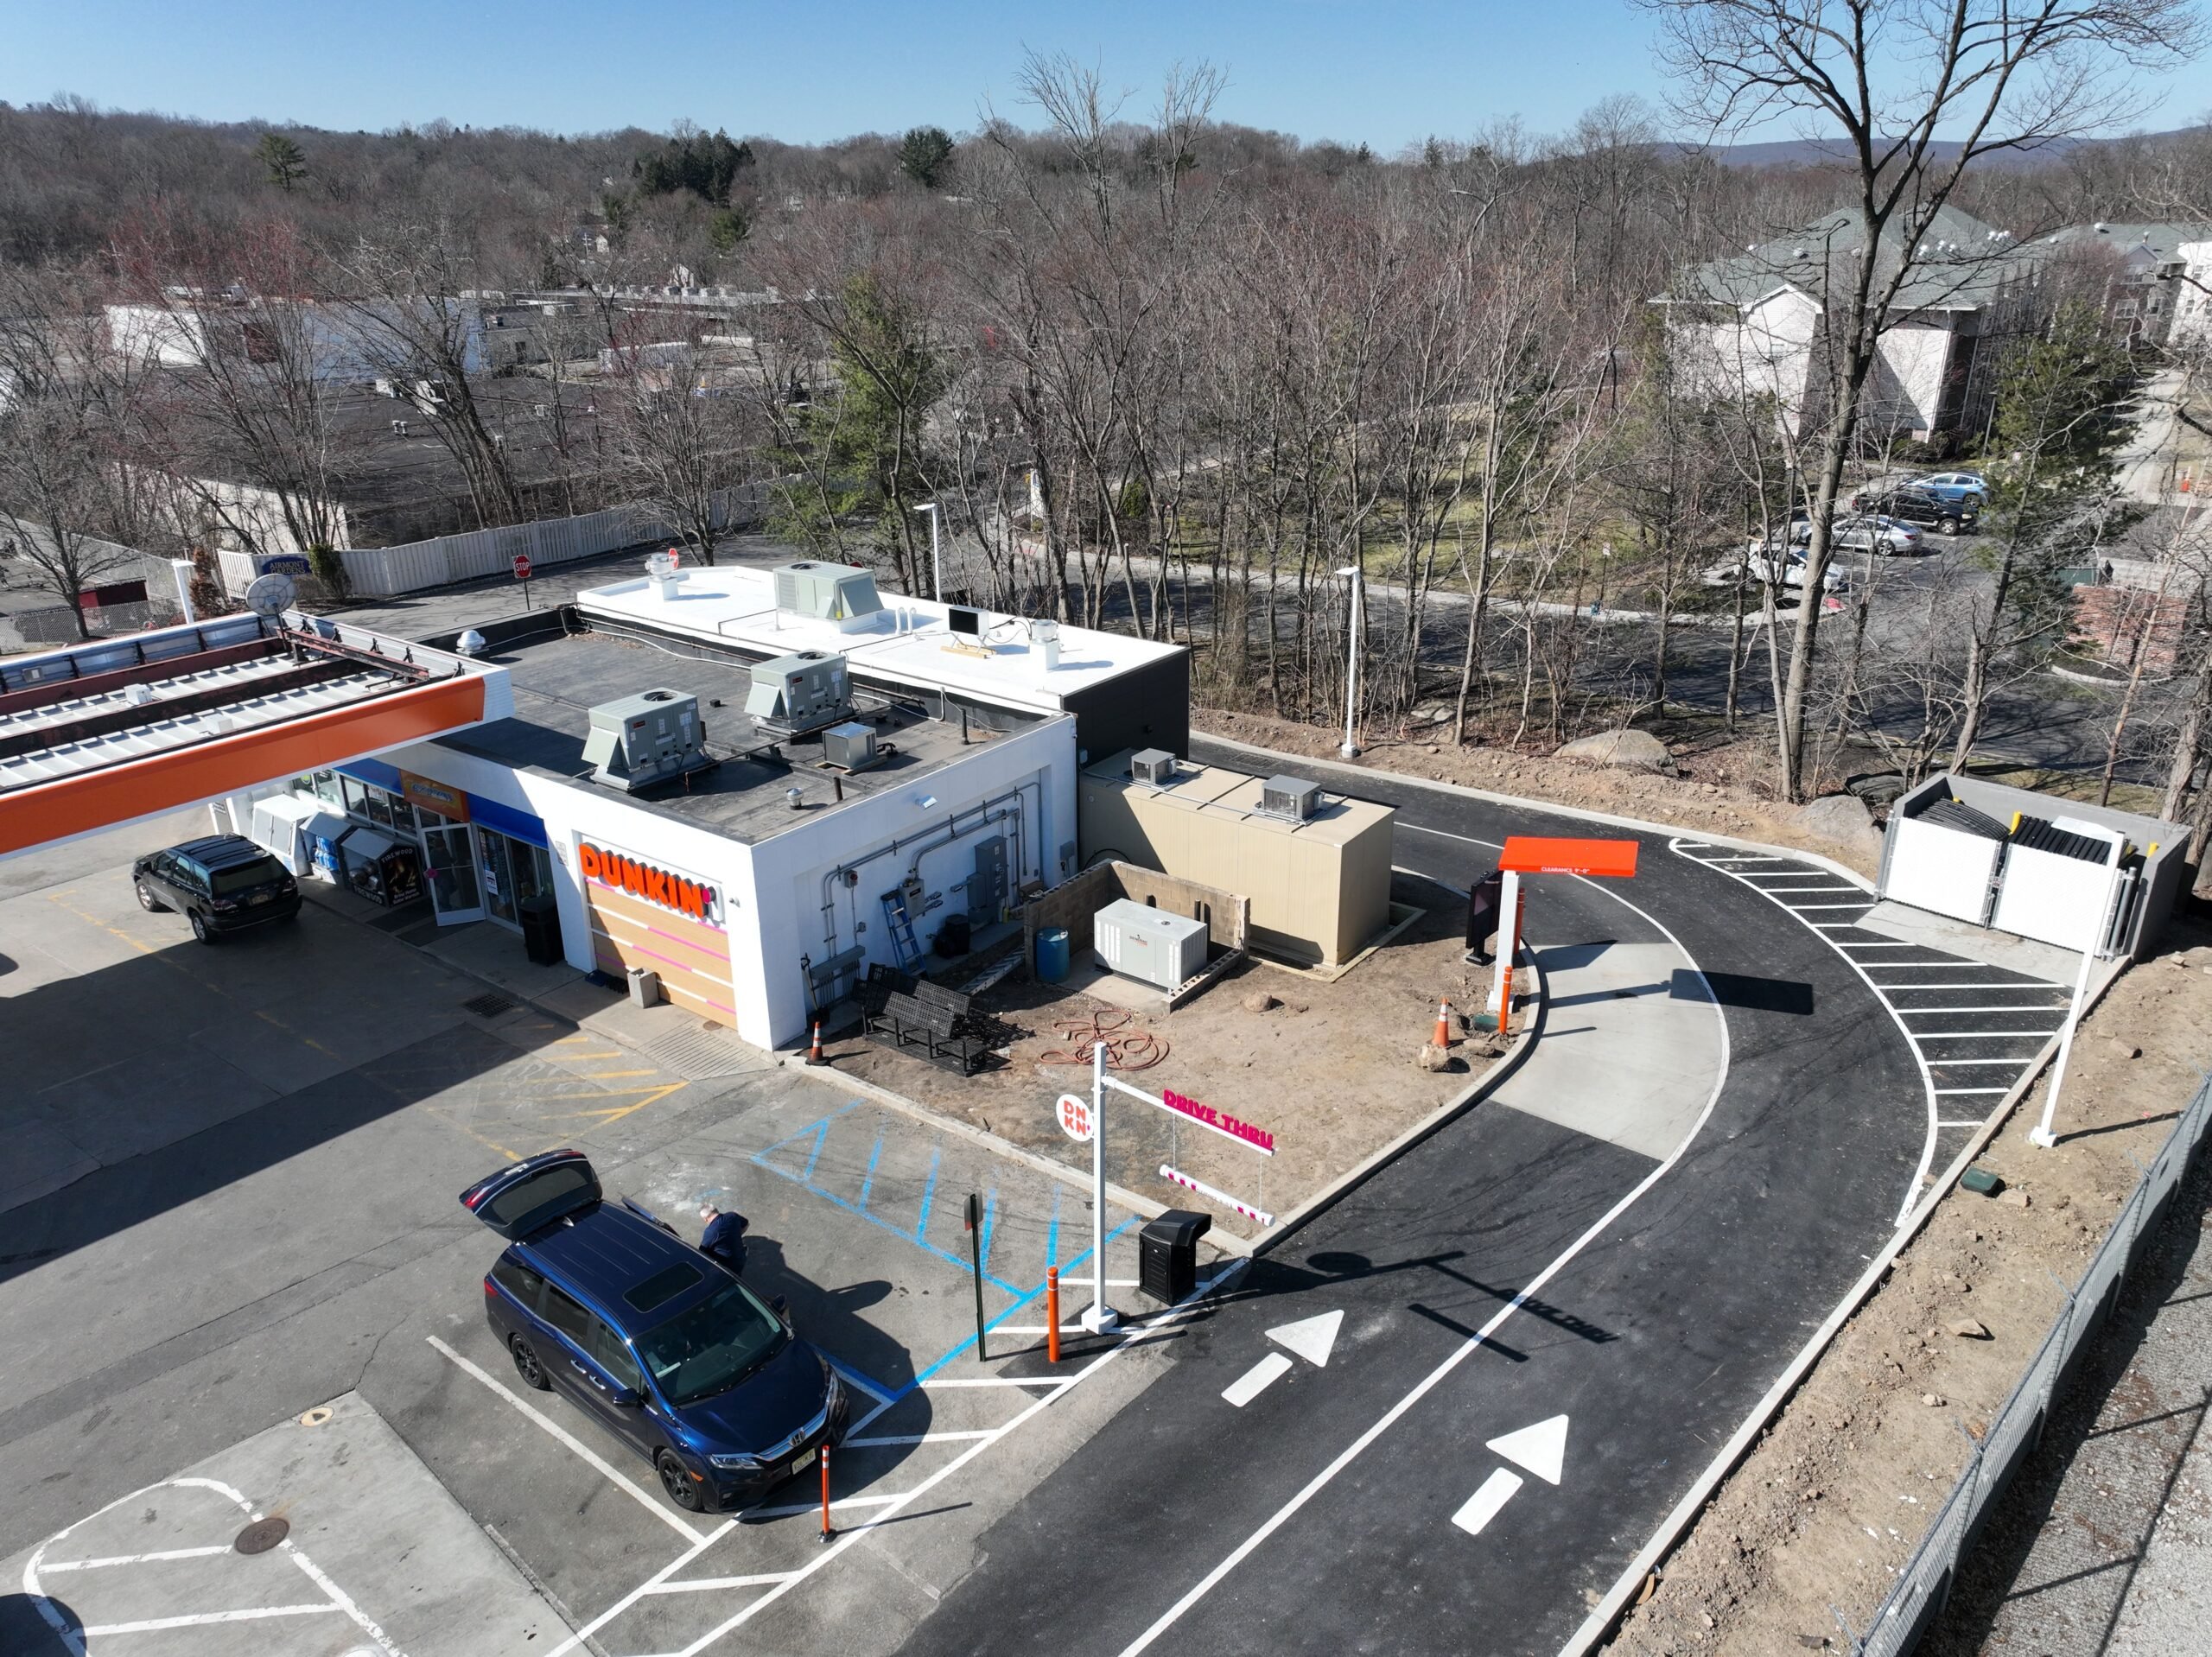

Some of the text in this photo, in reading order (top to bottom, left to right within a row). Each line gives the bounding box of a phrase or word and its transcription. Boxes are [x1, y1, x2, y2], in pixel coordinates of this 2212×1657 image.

[270, 561, 305, 569] AIRMONT
[515, 562, 530, 572] STOP
[381, 848, 413, 863] FIREWOOD
[1064, 1100, 1086, 1122] DN
[1164, 1088, 1274, 1151] DRIVE THRU
